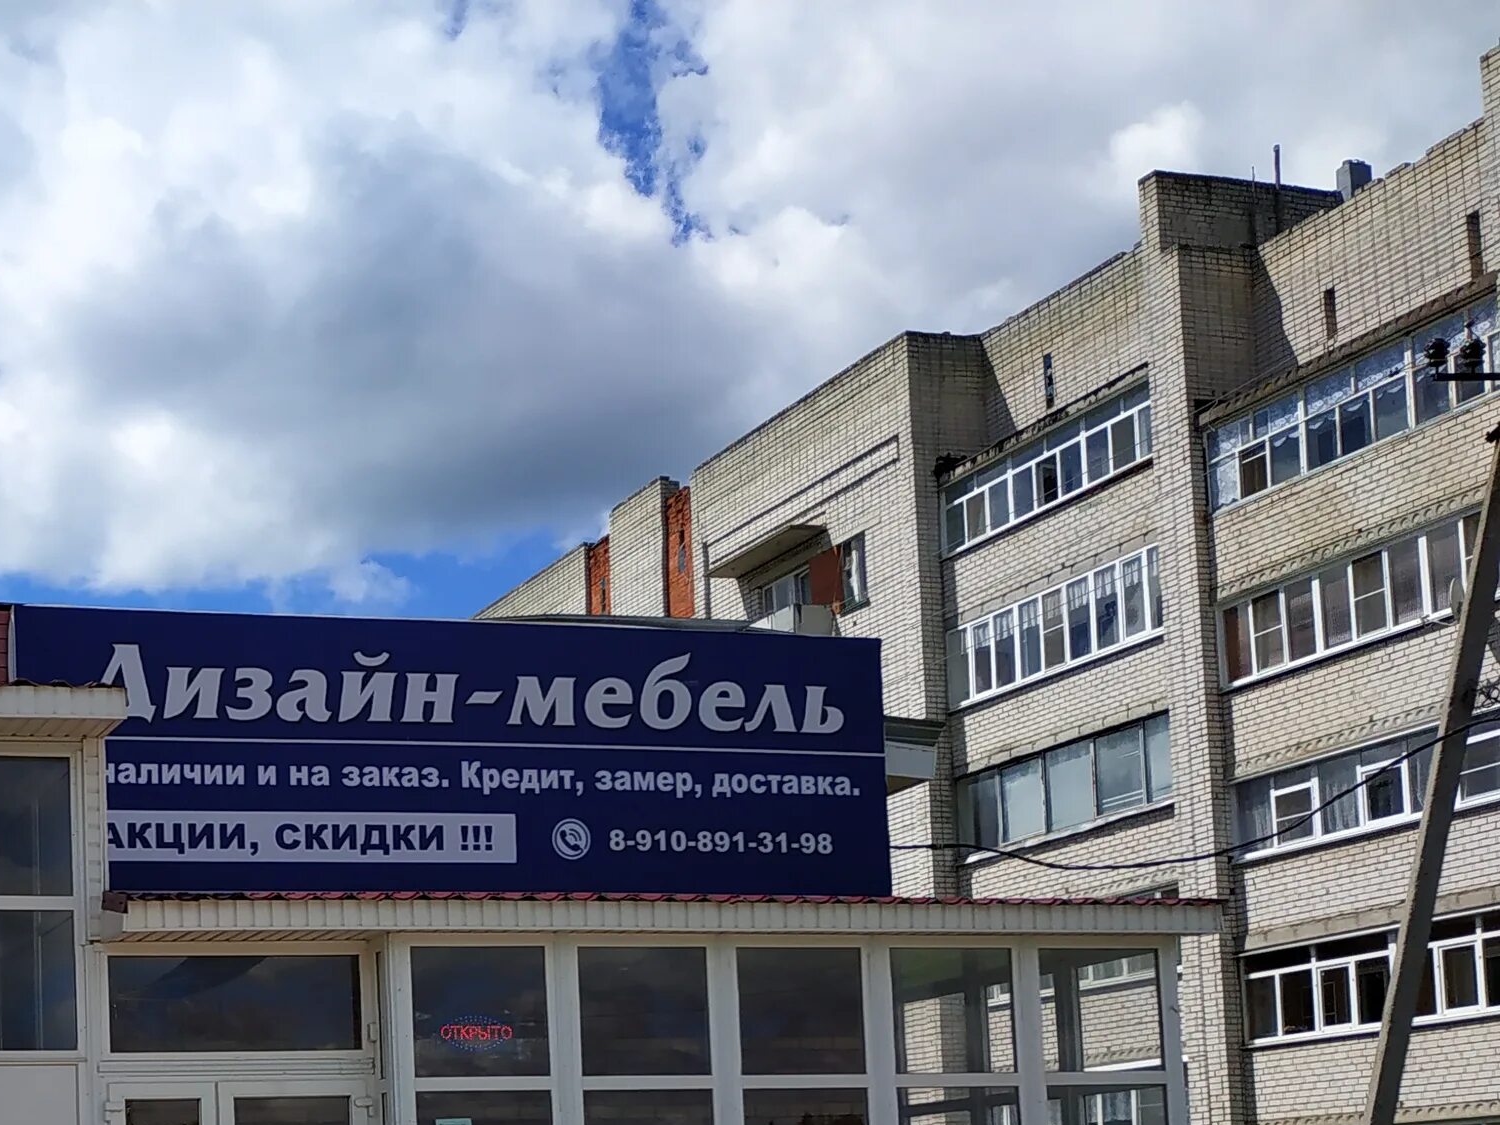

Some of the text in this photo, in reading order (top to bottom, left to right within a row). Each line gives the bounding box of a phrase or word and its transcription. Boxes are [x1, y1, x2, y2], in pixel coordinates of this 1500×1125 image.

[101, 643, 845, 734] Дизайн-мебель
[257, 764, 277, 786] и
[289, 765, 331, 787] на
[341, 766, 450, 788] заказ.
[460, 760, 585, 796] Кредит,
[594, 769, 702, 799] замер,
[712, 772, 861, 799] доставка.
[106, 822, 260, 856] АКЦИИ,
[274, 822, 445, 856] СКИДКИ
[608, 829, 834, 855] 8-910-891-31-98
[440, 1024, 513, 1041] ОТКРЫТО
